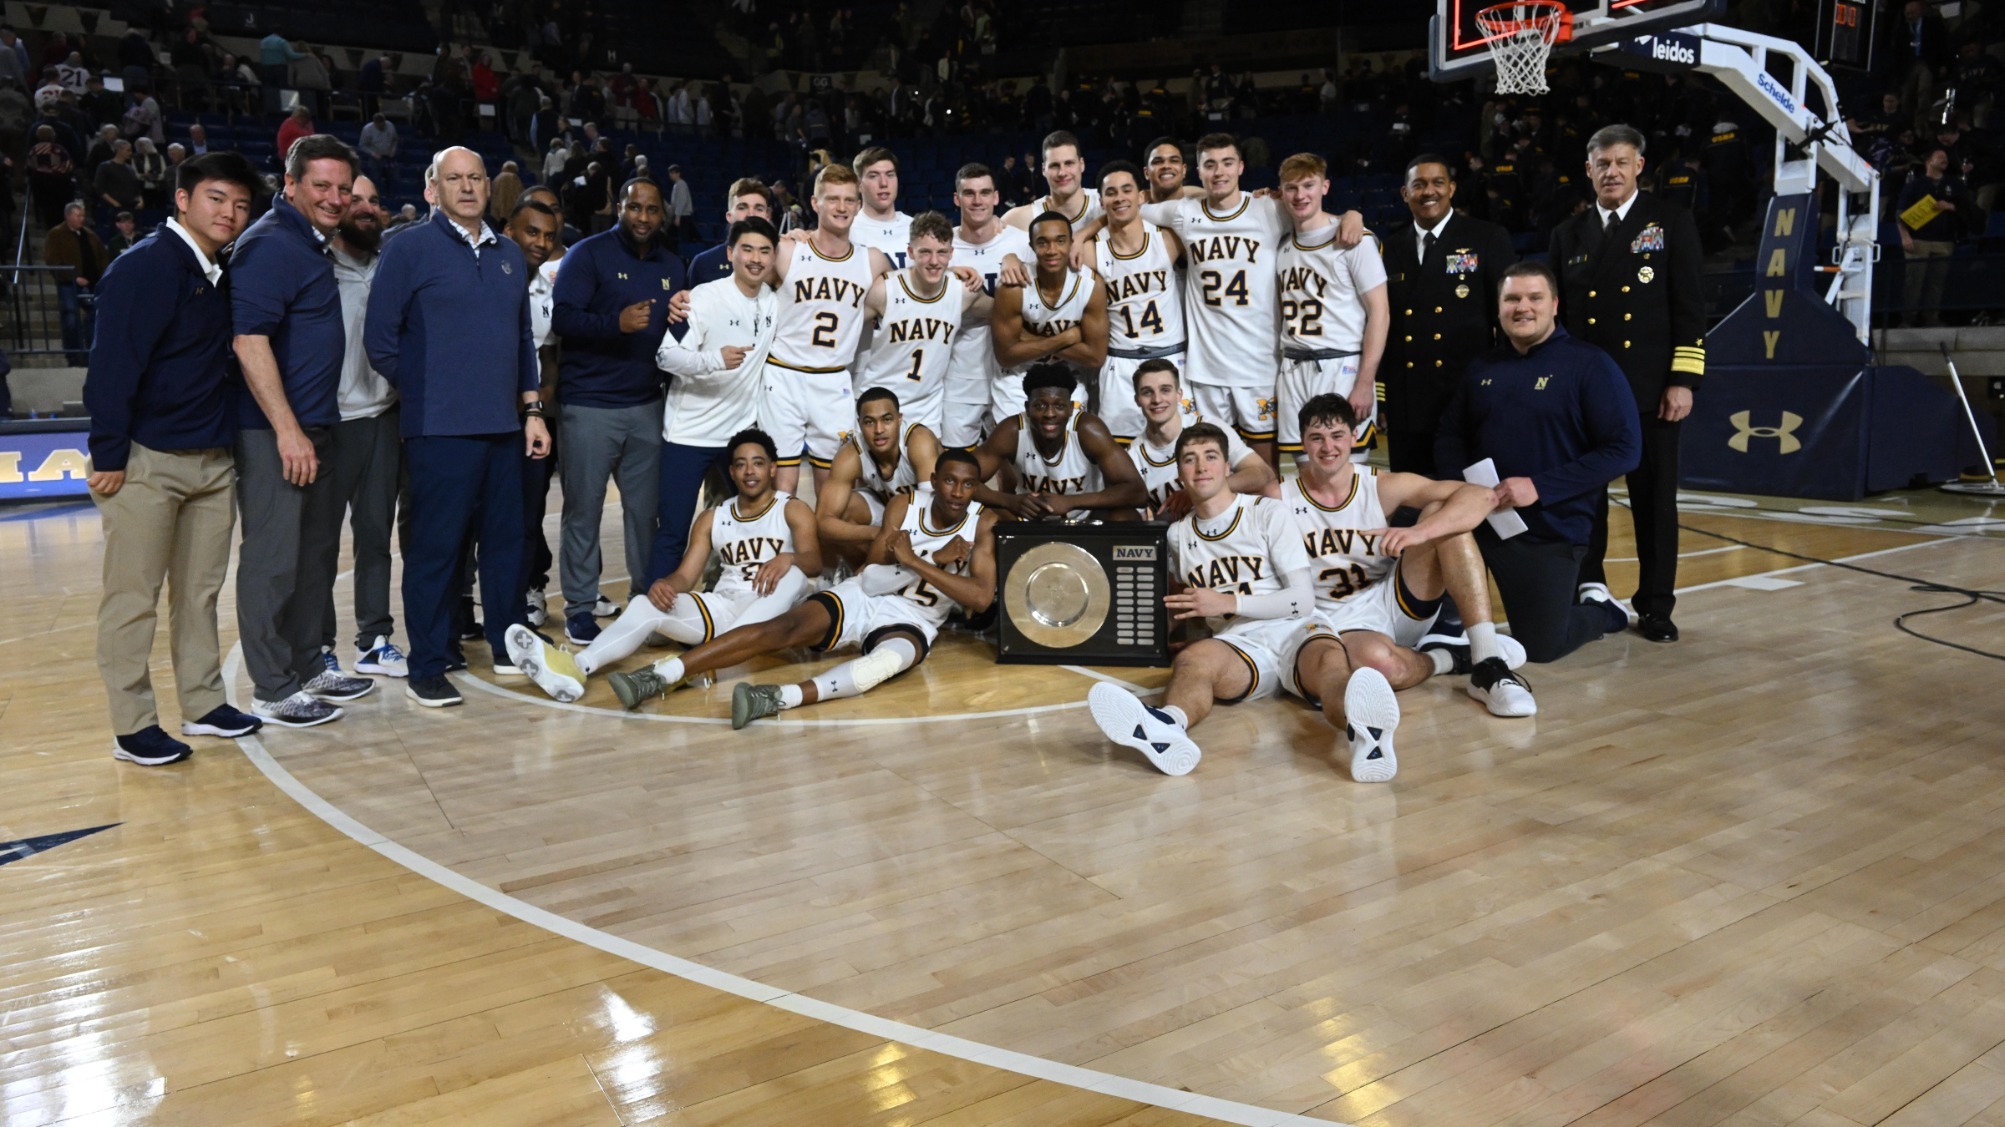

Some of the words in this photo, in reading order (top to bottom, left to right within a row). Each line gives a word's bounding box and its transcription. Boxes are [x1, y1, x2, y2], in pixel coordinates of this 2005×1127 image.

[1652, 37, 1695, 64] leidos
[61, 69, 82, 87] 21
[1757, 73, 1796, 114] Schelde
[1189, 236, 1260, 265] NAVY
[794, 276, 865, 308] NAVY
[1105, 270, 1167, 306] NAVY
[1201, 269, 1249, 306] 24
[1278, 266, 1328, 298] NAVY
[1763, 208, 1796, 360] NAVY
[812, 311, 839, 348] 2
[889, 317, 955, 345] NAVY
[1120, 300, 1164, 338] 14
[1282, 299, 1324, 336] 22
[907, 348, 924, 382] 1
[1021, 473, 1086, 496] NAVY
[720, 537, 784, 565] NAVY
[1116, 548, 1153, 558] NAVY
[1303, 528, 1377, 558] NAVY
[1187, 556, 1264, 588] NAVY
[1319, 563, 1371, 600] 31
